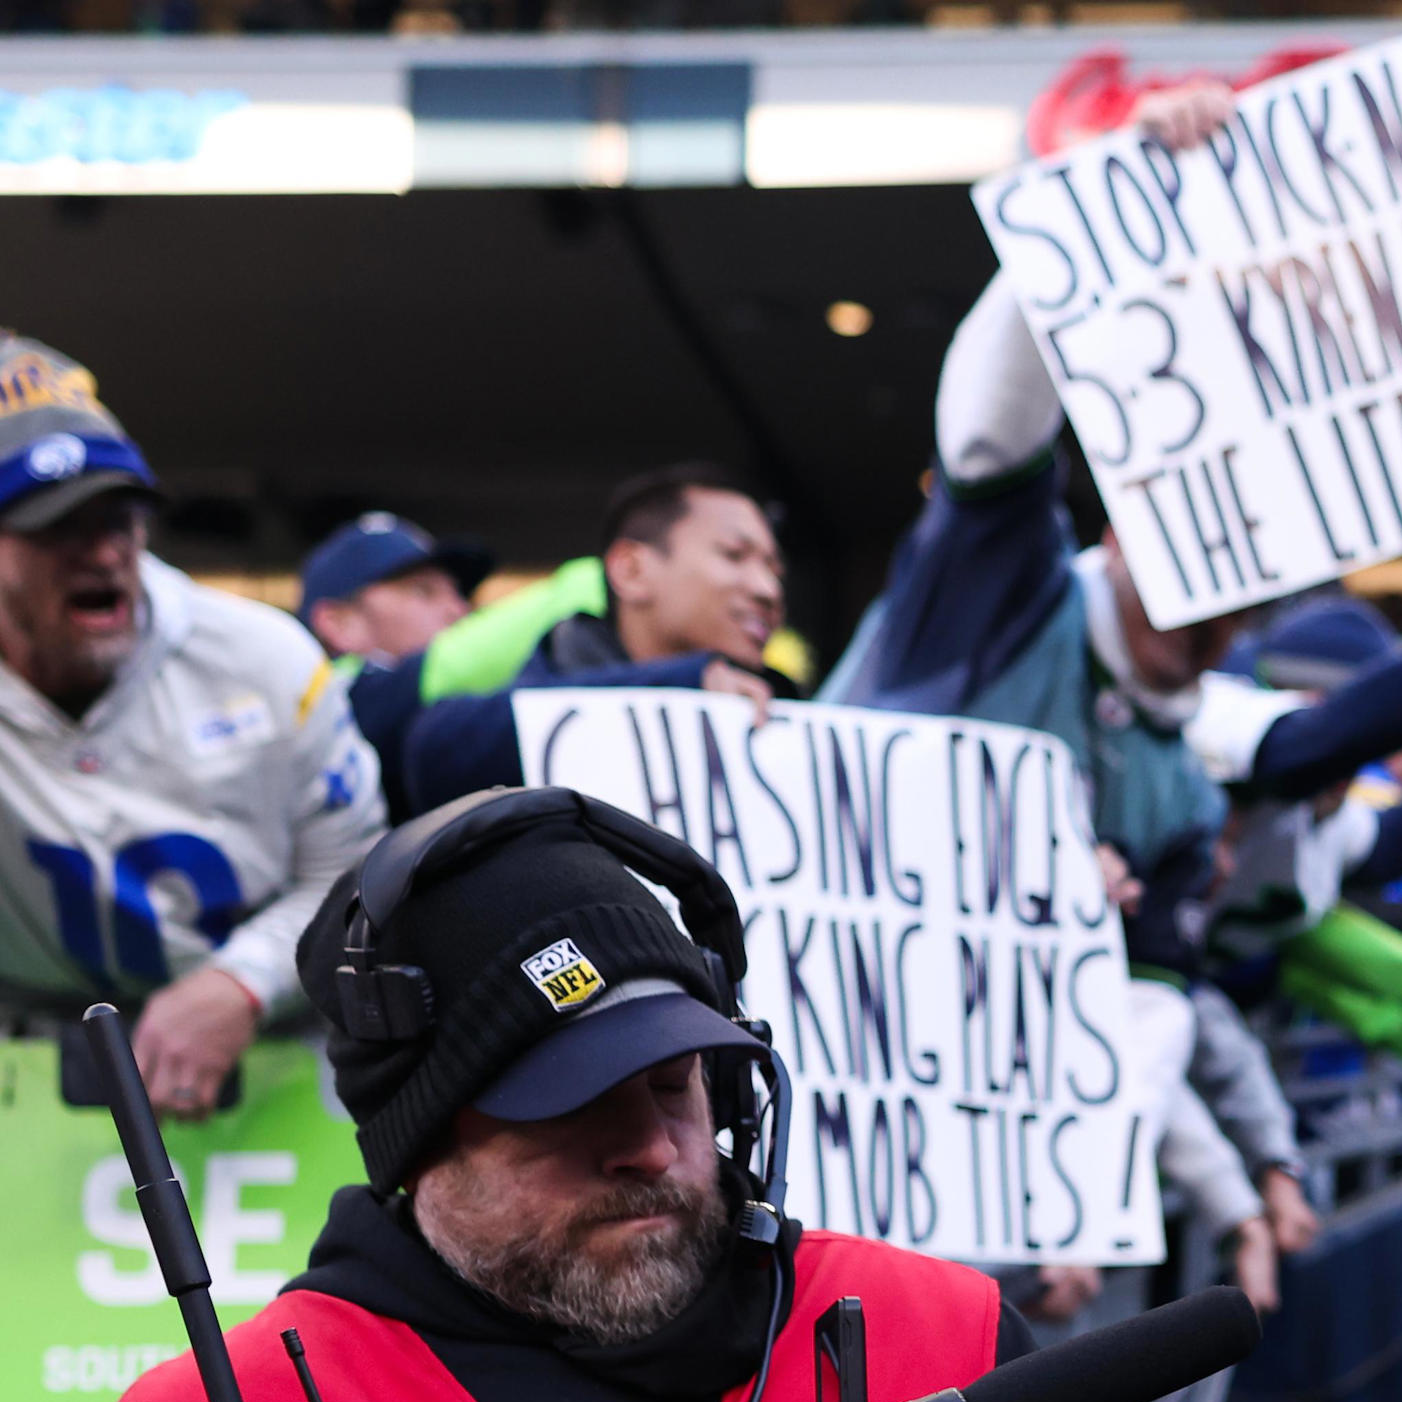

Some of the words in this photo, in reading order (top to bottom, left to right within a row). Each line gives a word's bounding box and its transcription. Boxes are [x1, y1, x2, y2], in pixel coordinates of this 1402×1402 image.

[996, 137, 1196, 312] STOP
[1121, 446, 1280, 599] THE
[527, 941, 581, 981] FOX
[542, 964, 597, 1004] NFL
[957, 933, 1119, 1104] PLAYS
[814, 1091, 937, 1244] MOB
